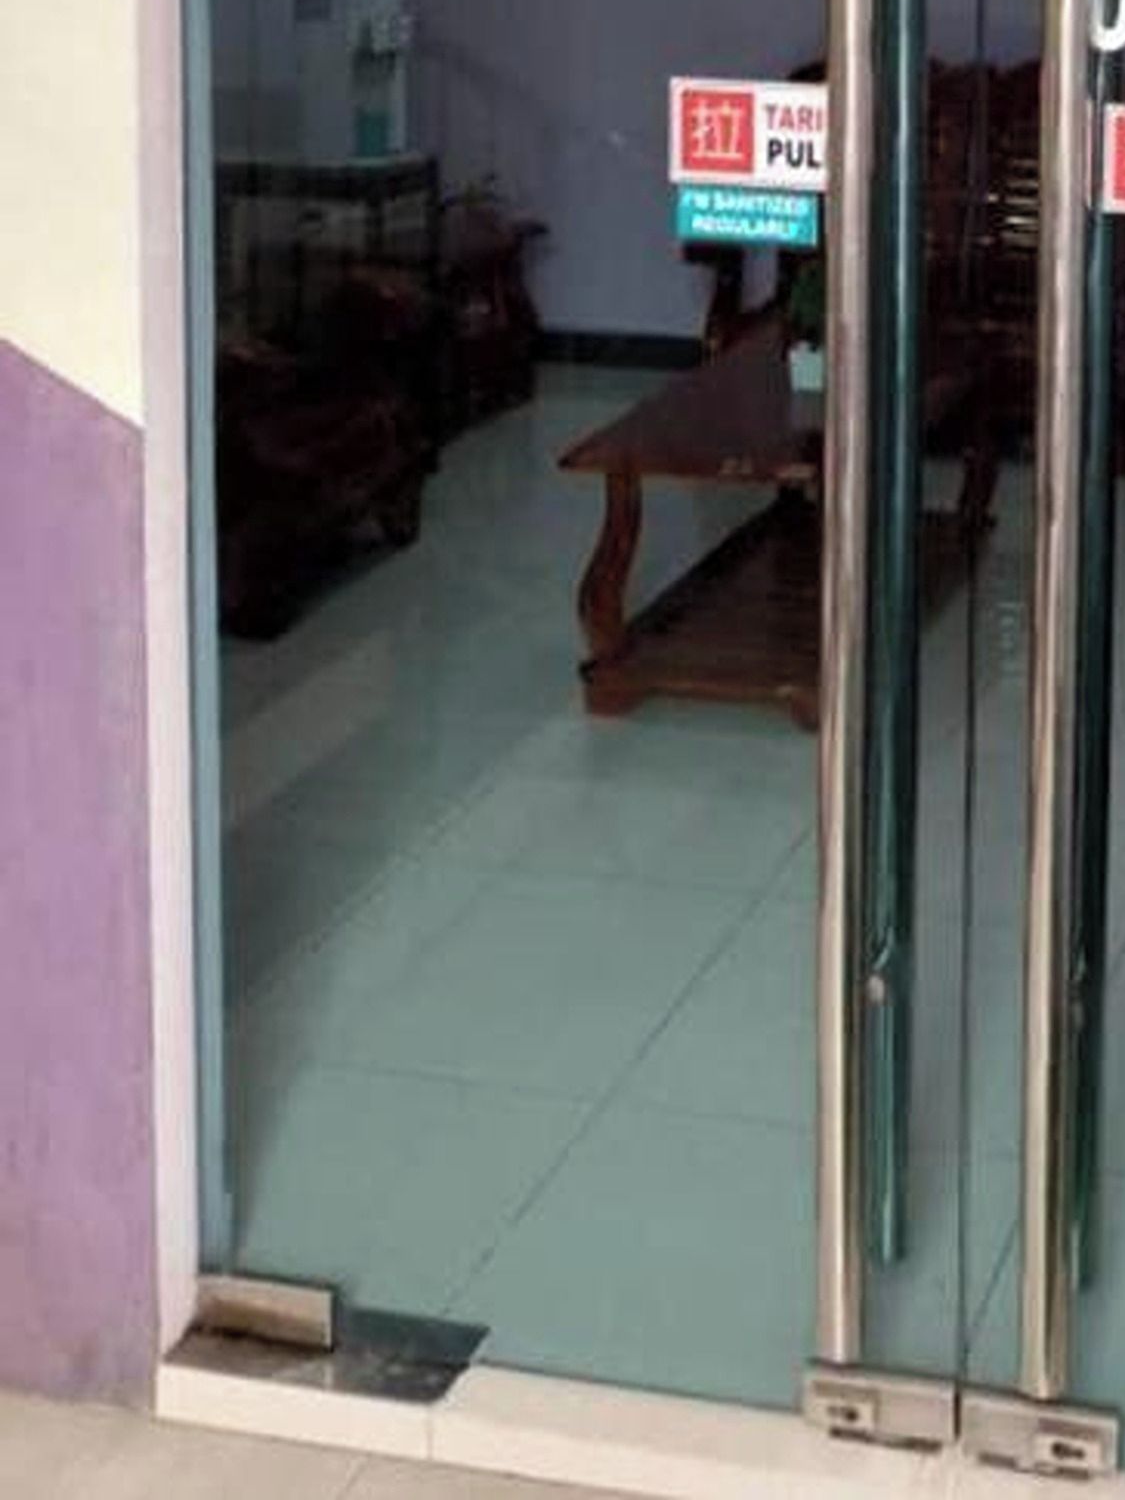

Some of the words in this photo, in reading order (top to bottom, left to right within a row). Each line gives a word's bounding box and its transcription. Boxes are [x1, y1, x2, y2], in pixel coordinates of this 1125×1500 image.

[689, 100, 745, 160] 拉
[764, 103, 823, 133] TARI
[766, 139, 822, 169] PUL
